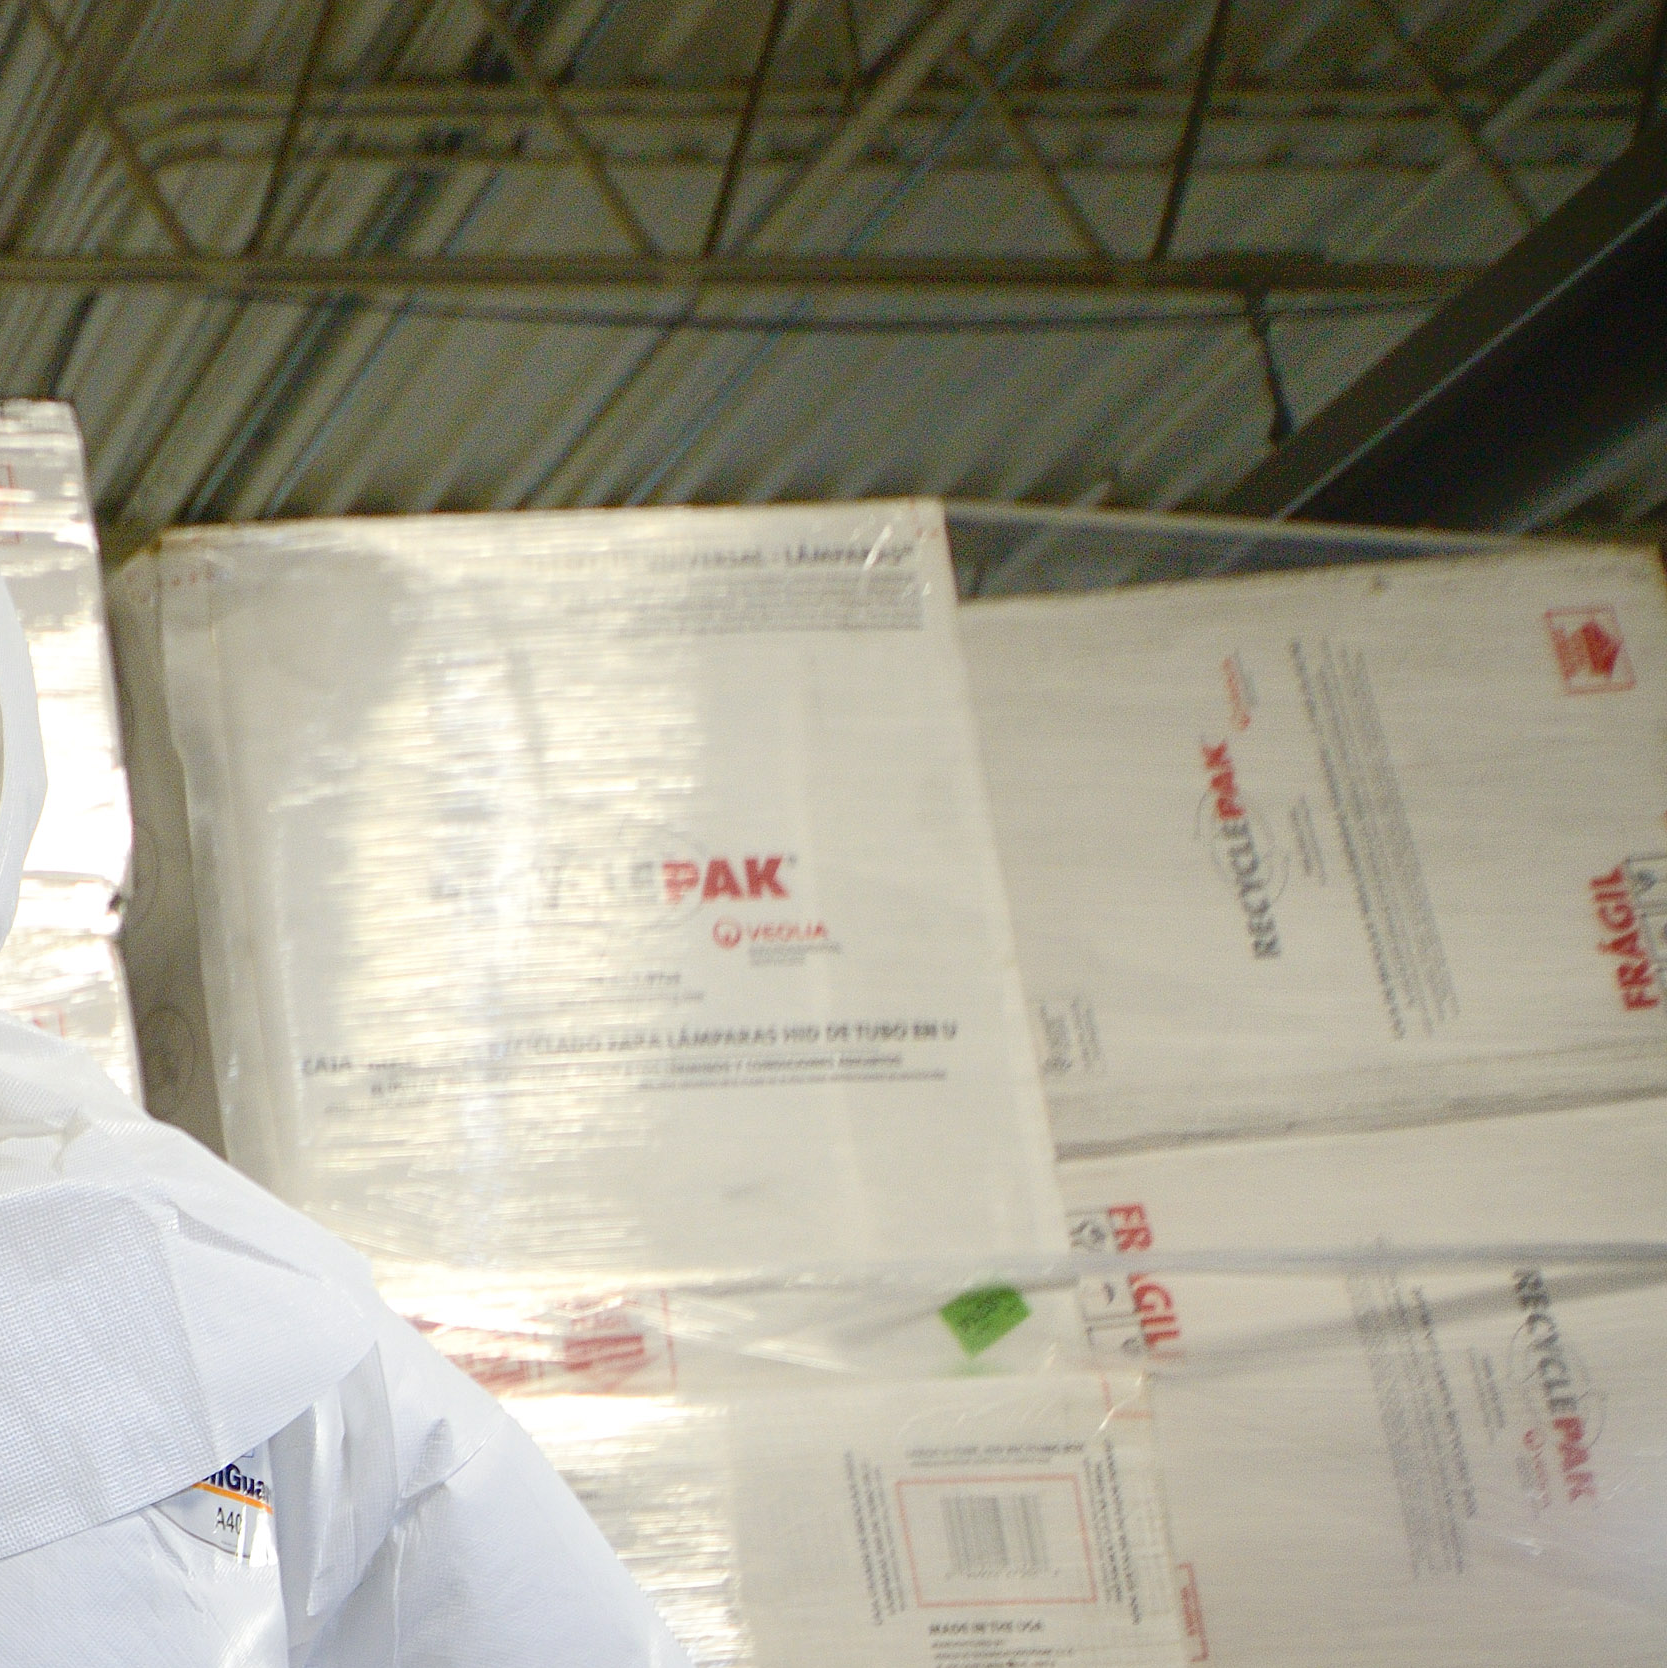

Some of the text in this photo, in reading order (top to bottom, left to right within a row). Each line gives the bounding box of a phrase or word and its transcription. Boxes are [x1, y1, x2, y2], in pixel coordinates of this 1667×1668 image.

[1588, 863, 1661, 1011] FRÁGIL
[1108, 1203, 1181, 1347] FRGIL
[1513, 1270, 1597, 1503] RECYCLEPAK
